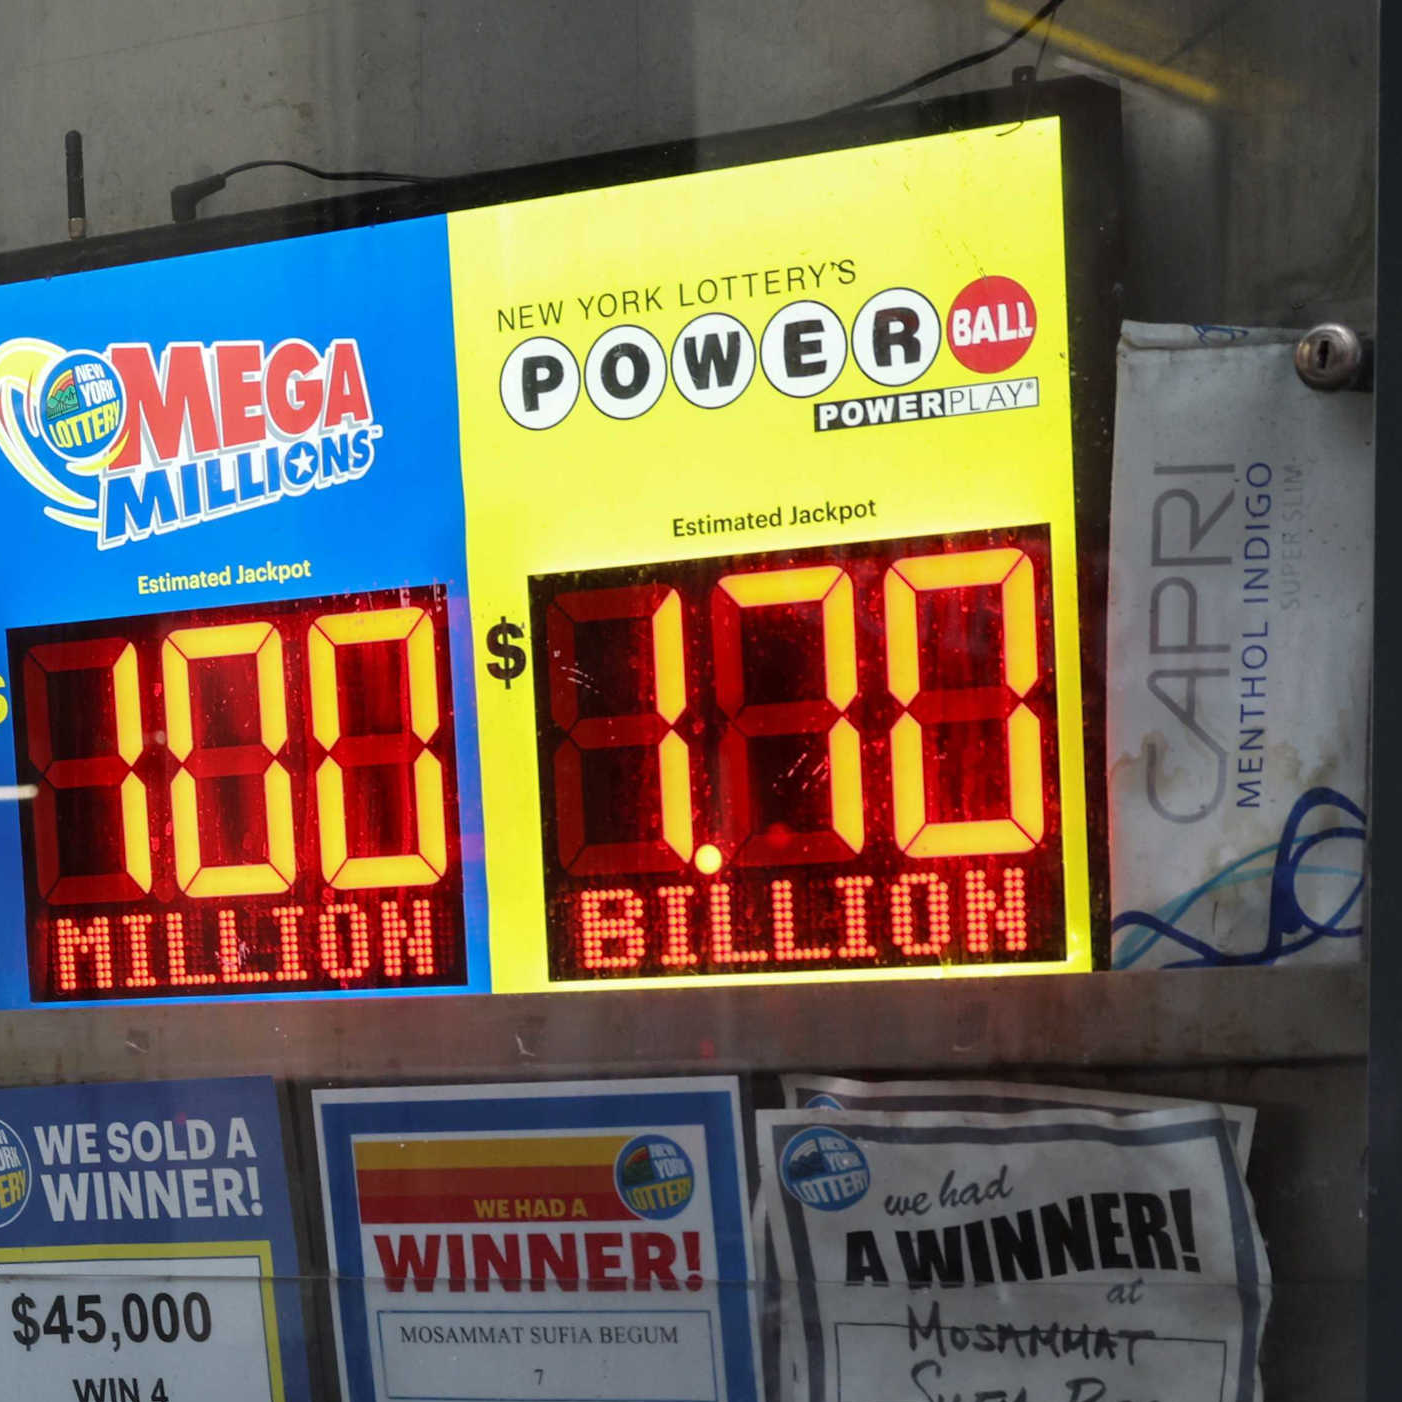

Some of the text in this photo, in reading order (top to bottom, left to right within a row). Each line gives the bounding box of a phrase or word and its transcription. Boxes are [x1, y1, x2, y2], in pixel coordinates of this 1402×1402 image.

[498, 260, 857, 332] NEW YORK LOTTERY'S
[75, 363, 105, 381] NEW
[80, 380, 114, 408] YORK
[51, 404, 121, 449] LOTTERY
[108, 341, 369, 470] MEGA
[102, 432, 372, 541] MILLIONS
[673, 499, 877, 537] Estimated Jackpot
[138, 559, 311, 594] Estimated Jackpot
[1146, 463, 1236, 823] CAPRI
[1237, 462, 1272, 807] MENTHOL INDIGO
[486, 548, 1044, 874] $ 1.70
[112, 607, 447, 898] 100
[56, 900, 434, 990] MILLION
[581, 868, 1027, 968] BILLION
[34, 1117, 257, 1165] WE SOLD A
[41, 1167, 264, 1222] WINNER!
[474, 1198, 589, 1219] WE HAD A
[885, 1171, 1013, 1217] we had
[374, 1231, 704, 1293] WINNER!
[846, 1188, 1201, 1290] A WINNER!
[11, 1292, 211, 1351] $45,000
[400, 1326, 679, 1345] MOSAMMAT SUFIA BEGUM
[534, 1369, 544, 1385] 7
